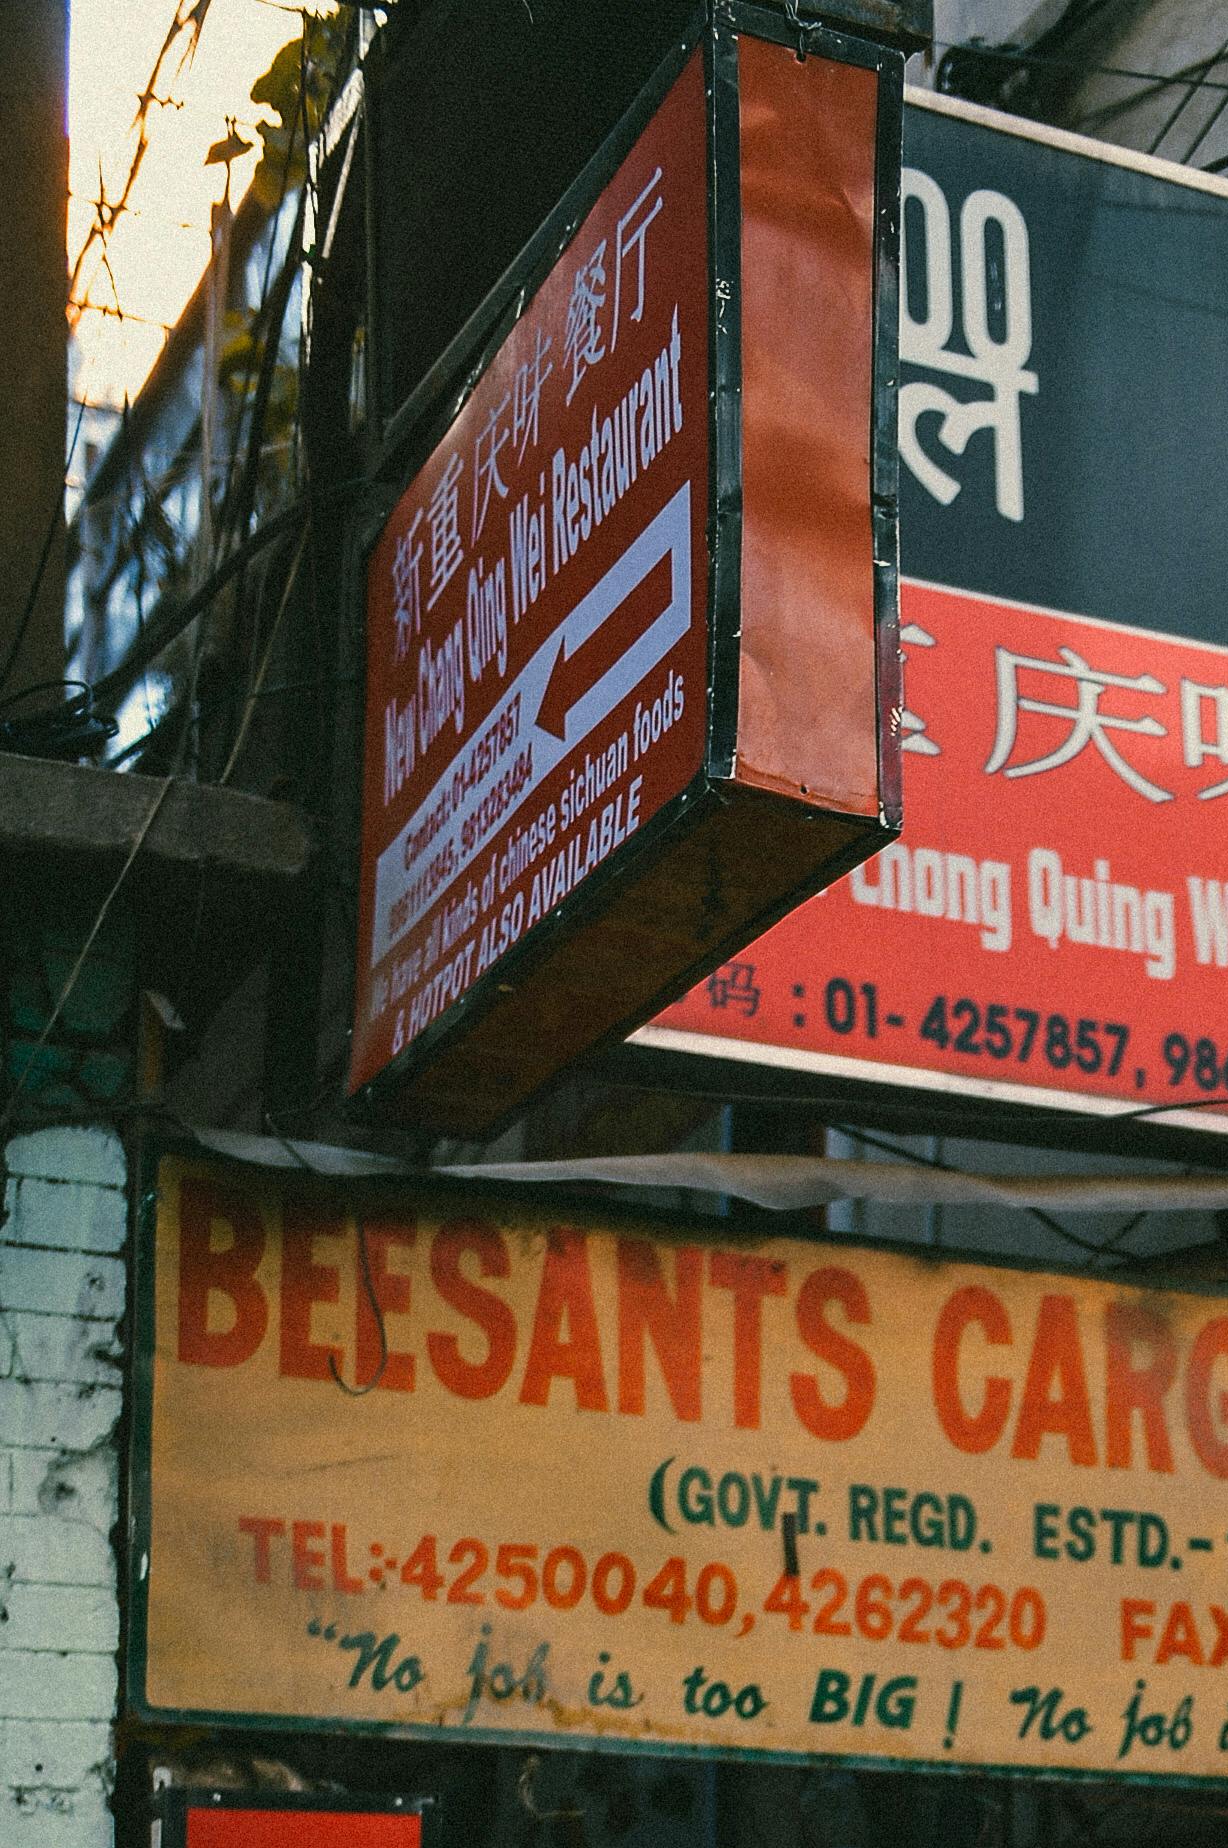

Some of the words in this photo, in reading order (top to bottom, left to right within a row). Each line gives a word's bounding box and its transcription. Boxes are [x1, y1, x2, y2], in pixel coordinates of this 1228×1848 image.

[391, 166, 663, 665] 新重庆味餐厅
[509, 471, 546, 625] Wei
[552, 303, 683, 576] Restaurant
[407, 945, 475, 1046] HOTPOT
[476, 890, 524, 977] ALSO
[527, 774, 643, 929] AVAILABLE
[481, 853, 497, 910] of
[499, 804, 556, 894] chinese
[560, 750, 629, 832] sichuan
[633, 669, 685, 761] foods
[1027, 847, 1176, 981] Quing
[920, 996, 1146, 1088] 4257857,
[174, 1177, 878, 1443] BEESANTS
[647, 1455, 828, 1536] (GOVT.
[848, 1483, 994, 1556] REGD.
[588, 1651, 645, 1710] is
[681, 1666, 767, 1721] too
[809, 1669, 918, 1731] BIG
[1117, 1679, 1195, 1759] job
